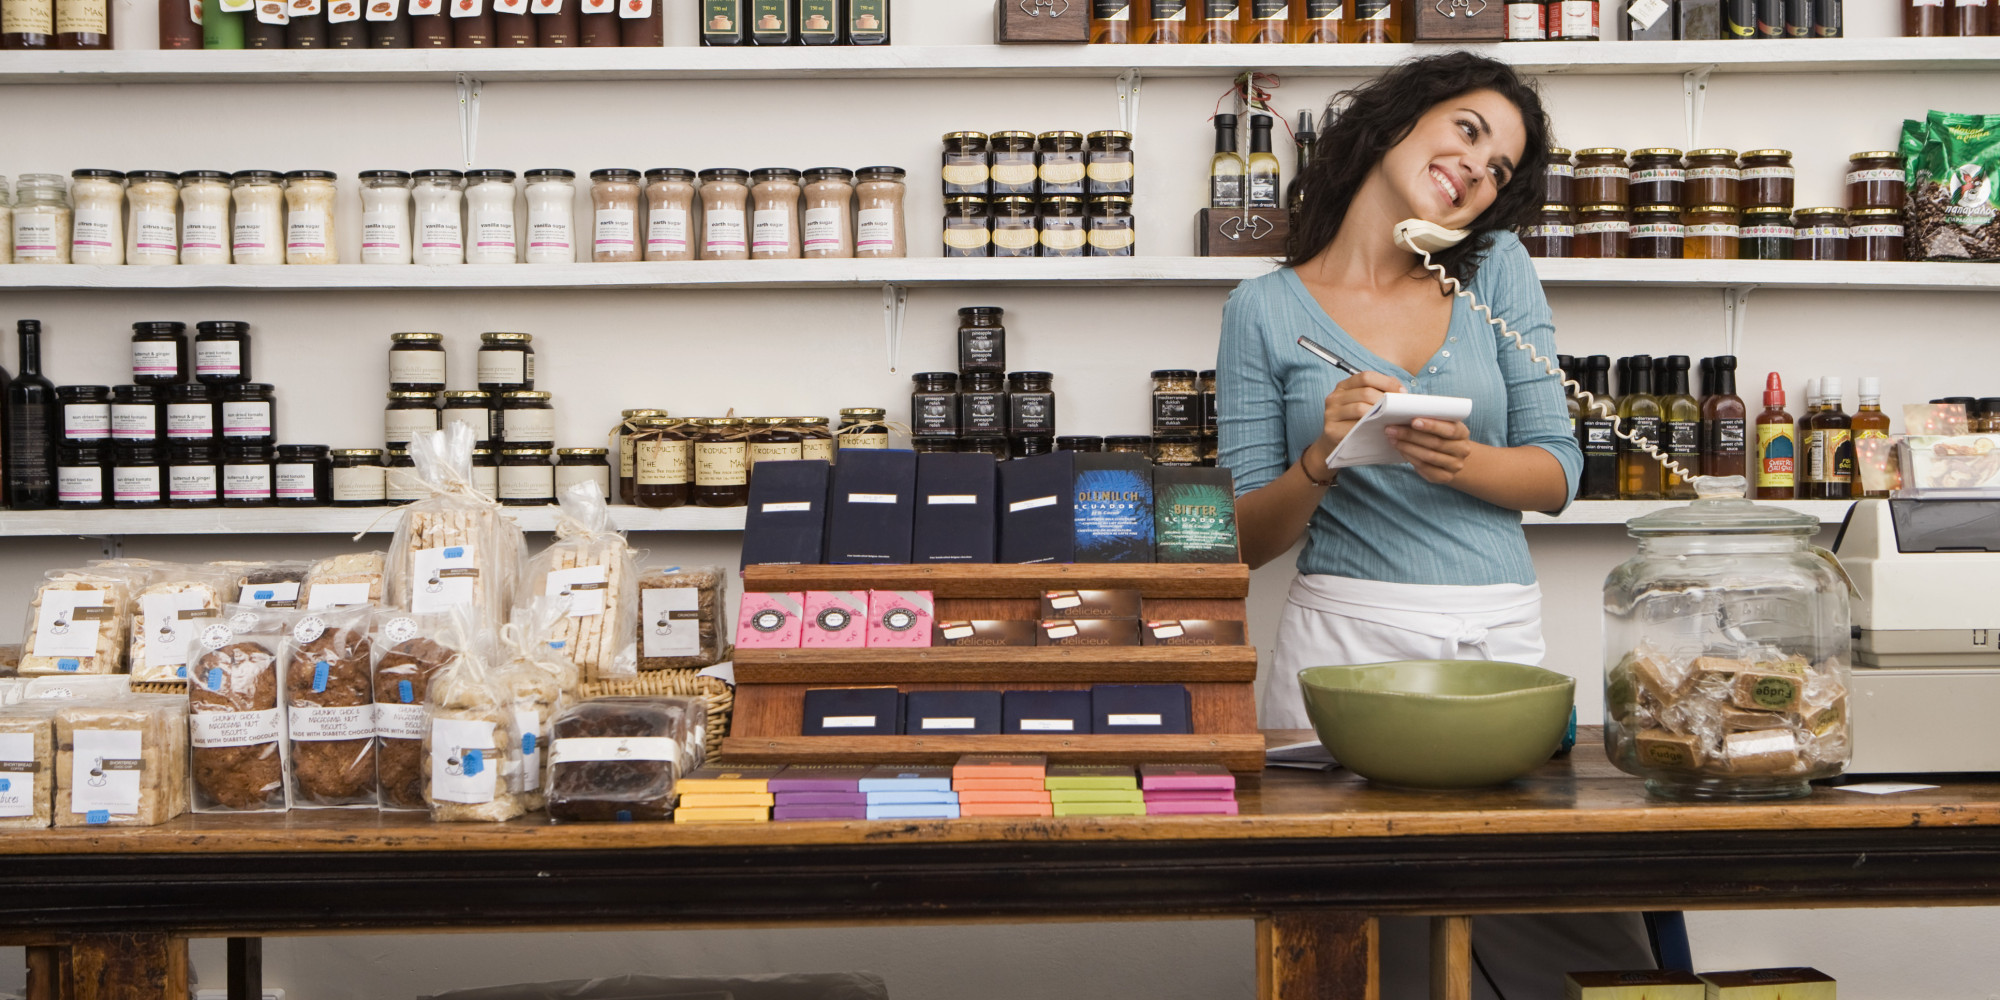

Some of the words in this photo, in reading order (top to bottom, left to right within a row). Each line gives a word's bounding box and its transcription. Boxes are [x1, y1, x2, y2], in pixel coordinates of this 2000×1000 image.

[699, 445, 733, 455] PRODUCT
[753, 446, 787, 455] PRODUCT
[641, 457, 656, 468] THE
[699, 460, 713, 468] THE
[1174, 504, 1217, 516] BITTER
[1164, 516, 1224, 524] ECUADOR
[1064, 606, 1112, 616] délicieux
[956, 636, 1006, 646] délicieux
[1061, 636, 1110, 646] délicieux
[1167, 636, 1216, 646] délicieux
[1756, 688, 1792, 699] Fudge
[212, 714, 237, 722] CHUNKY
[240, 713, 255, 721] CHOC
[312, 709, 336, 717] CHUNKY
[208, 722, 242, 730] MACADAMIA
[244, 720, 258, 728] NUT
[308, 716, 341, 724] MACADAMIA
[320, 722, 348, 730] BISCUITS
[348, 727, 377, 735] CHOCOLAT
[221, 728, 248, 736] BISCUITS
[248, 731, 279, 741] CHOCOLATE
[1650, 750, 1683, 762] Fudge
